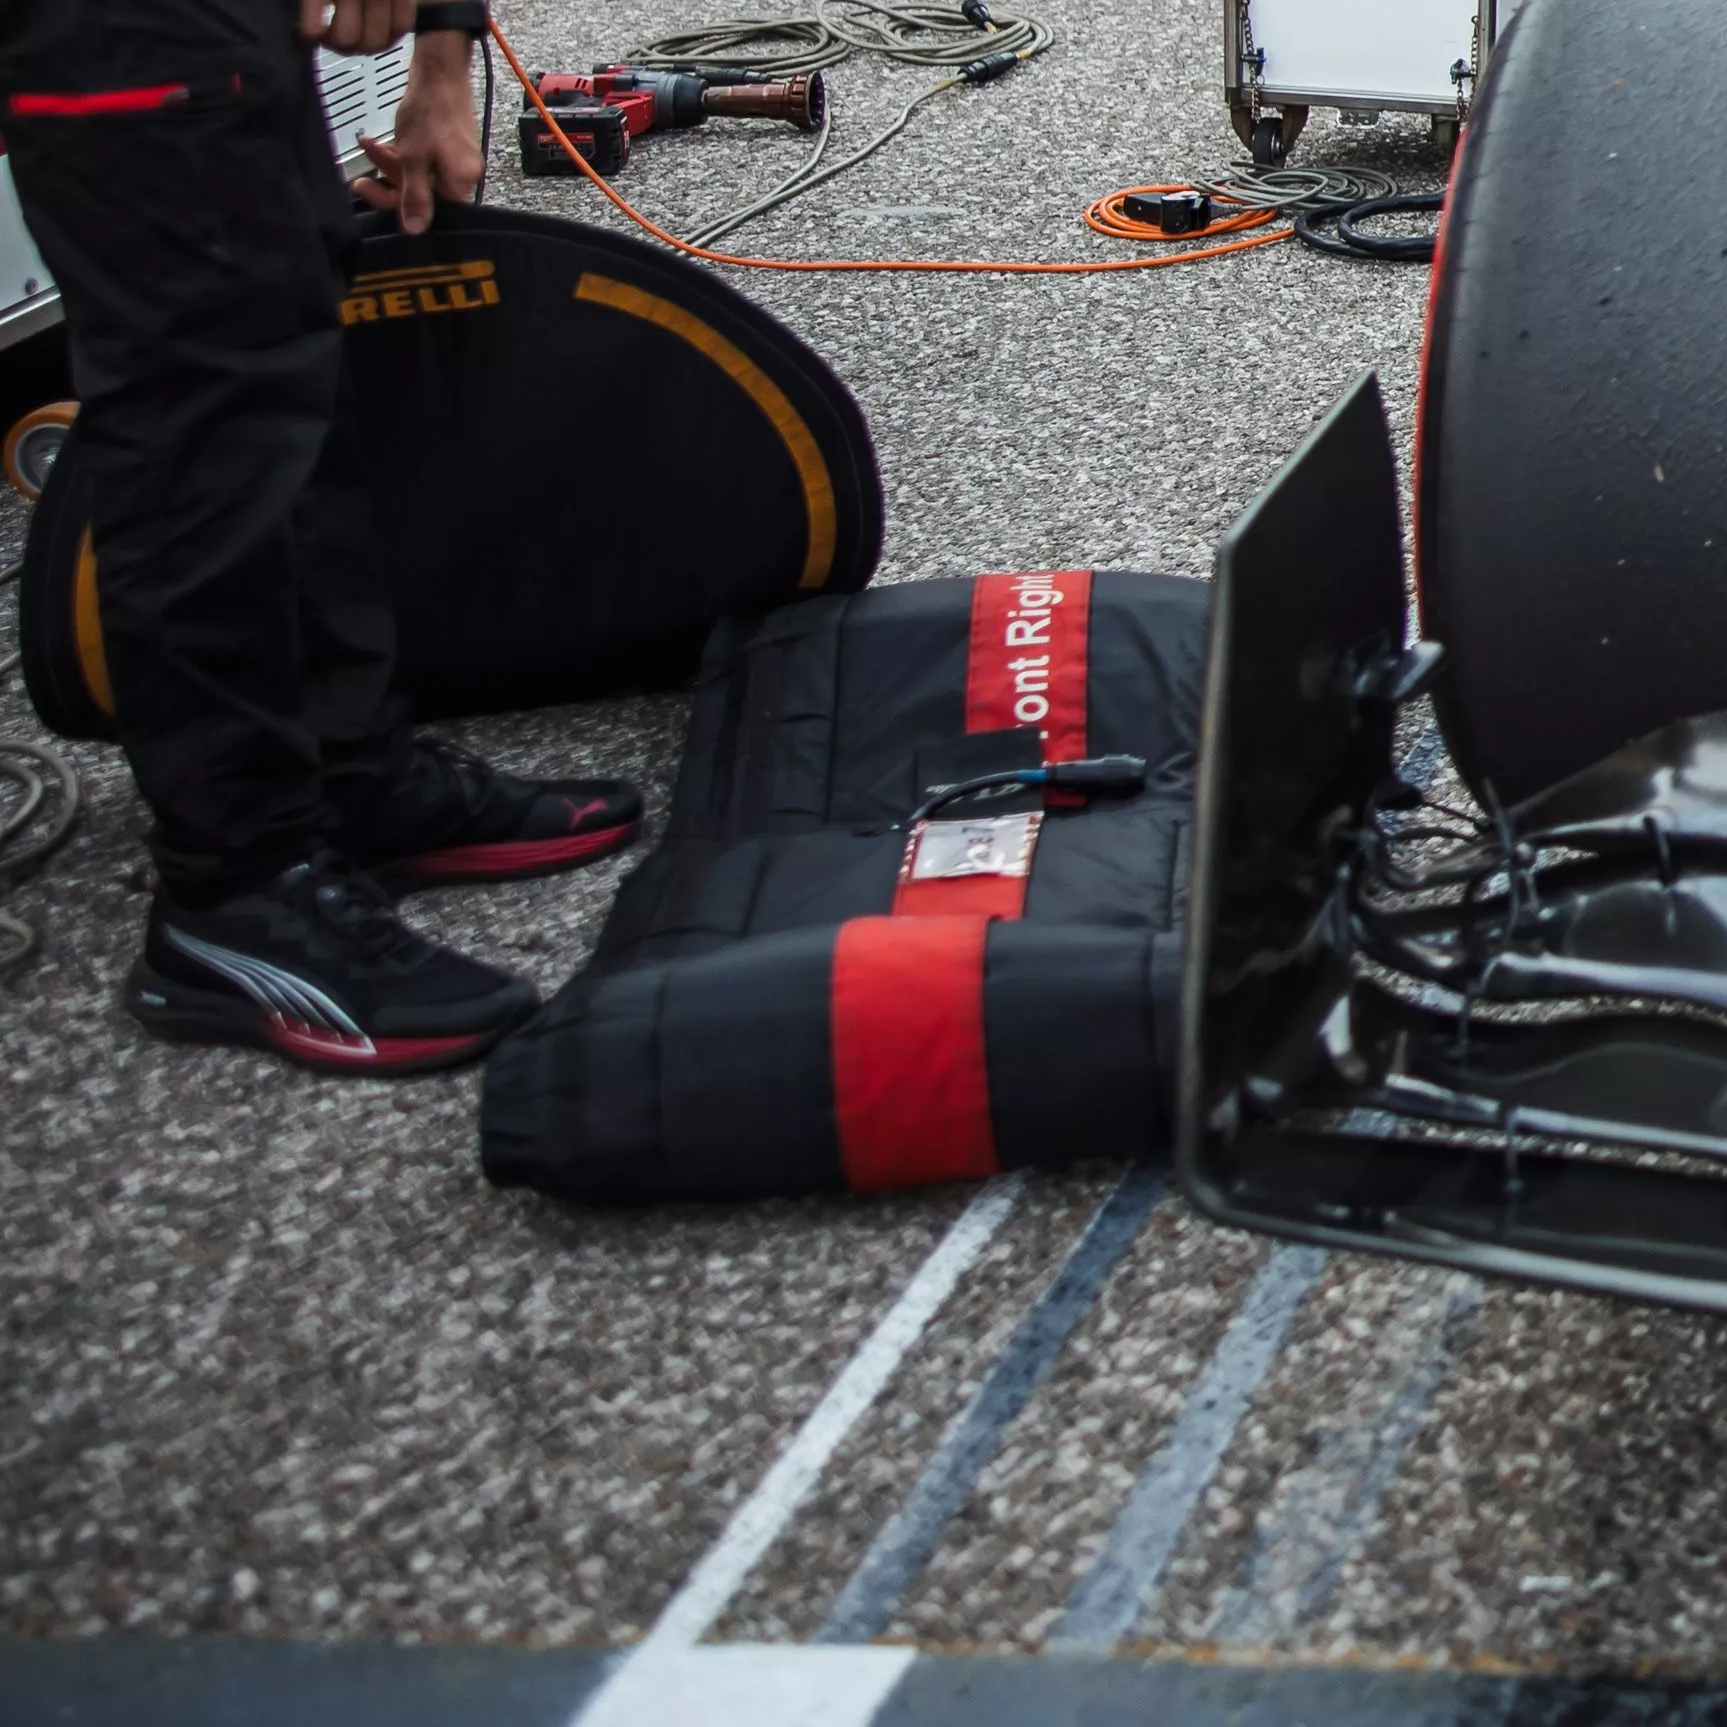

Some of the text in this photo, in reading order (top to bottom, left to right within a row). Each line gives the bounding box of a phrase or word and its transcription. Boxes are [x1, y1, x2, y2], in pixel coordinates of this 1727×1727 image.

[340, 260, 501, 326] RELLI
[1005, 573, 1065, 723] ont Right
